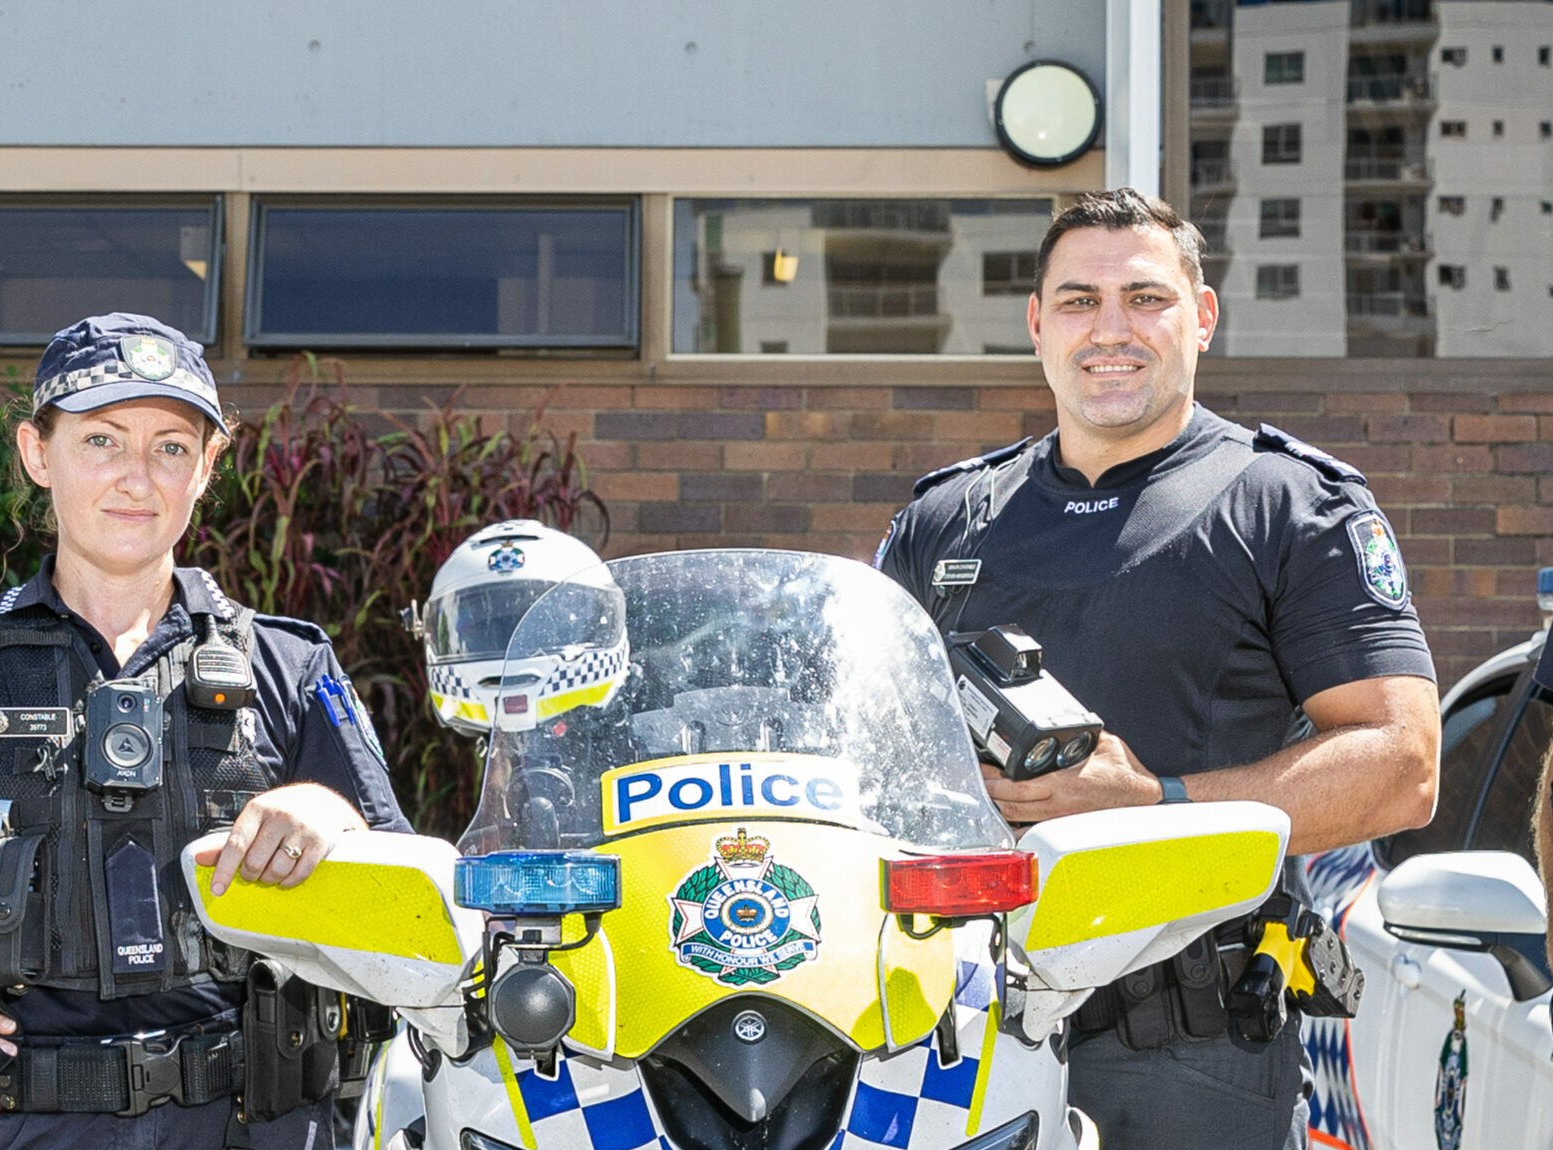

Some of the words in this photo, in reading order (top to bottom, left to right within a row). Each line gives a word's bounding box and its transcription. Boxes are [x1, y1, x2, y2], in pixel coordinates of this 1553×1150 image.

[1064, 497, 1119, 514] POLICE
[617, 763, 843, 824] Police
[704, 880, 789, 920] QUEENSLAND
[718, 929, 777, 947] POLICE
[117, 943, 163, 956] QUEENSLAND
[128, 954, 155, 965] POLICE
